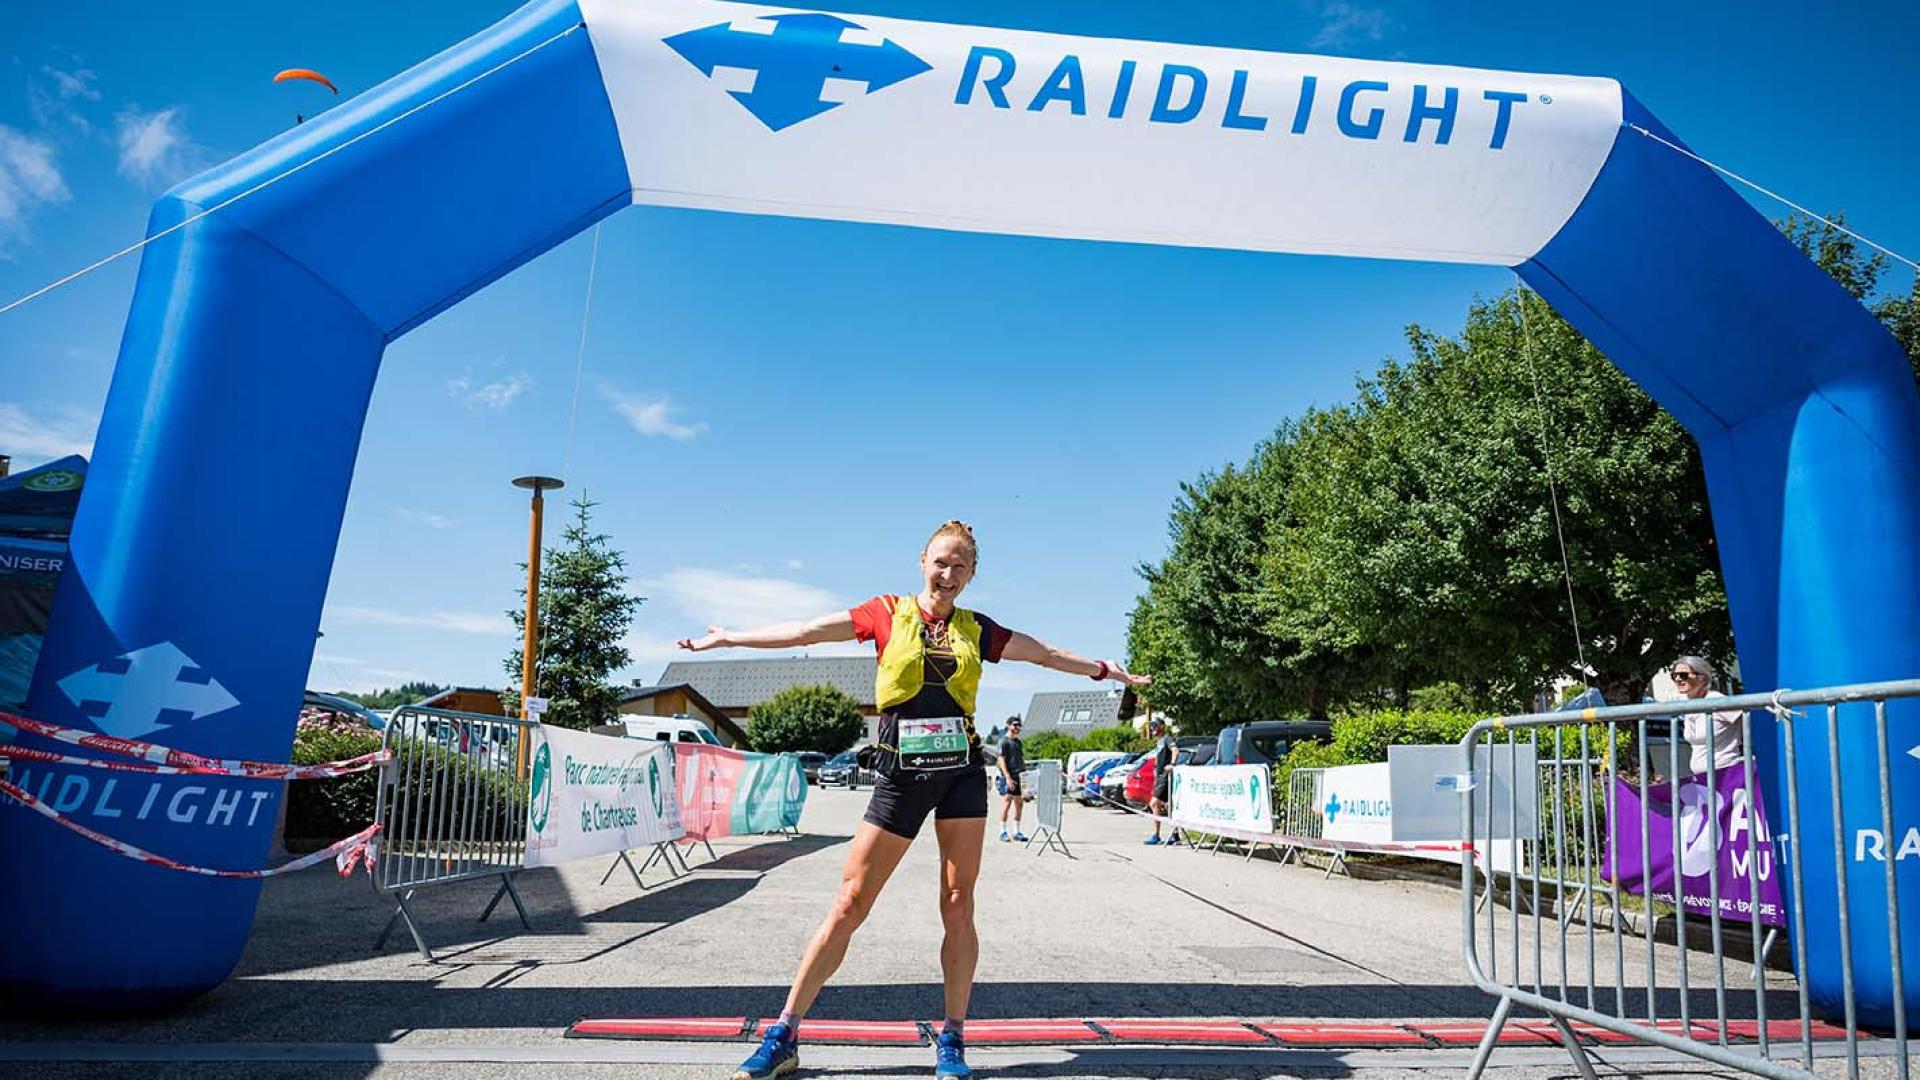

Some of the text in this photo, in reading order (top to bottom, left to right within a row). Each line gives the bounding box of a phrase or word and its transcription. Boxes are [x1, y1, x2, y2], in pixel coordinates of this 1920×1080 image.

[933, 736, 957, 749] 641
[565, 755, 588, 785] Parc
[581, 800, 592, 832] de
[593, 800, 638, 830] Chartreuse
